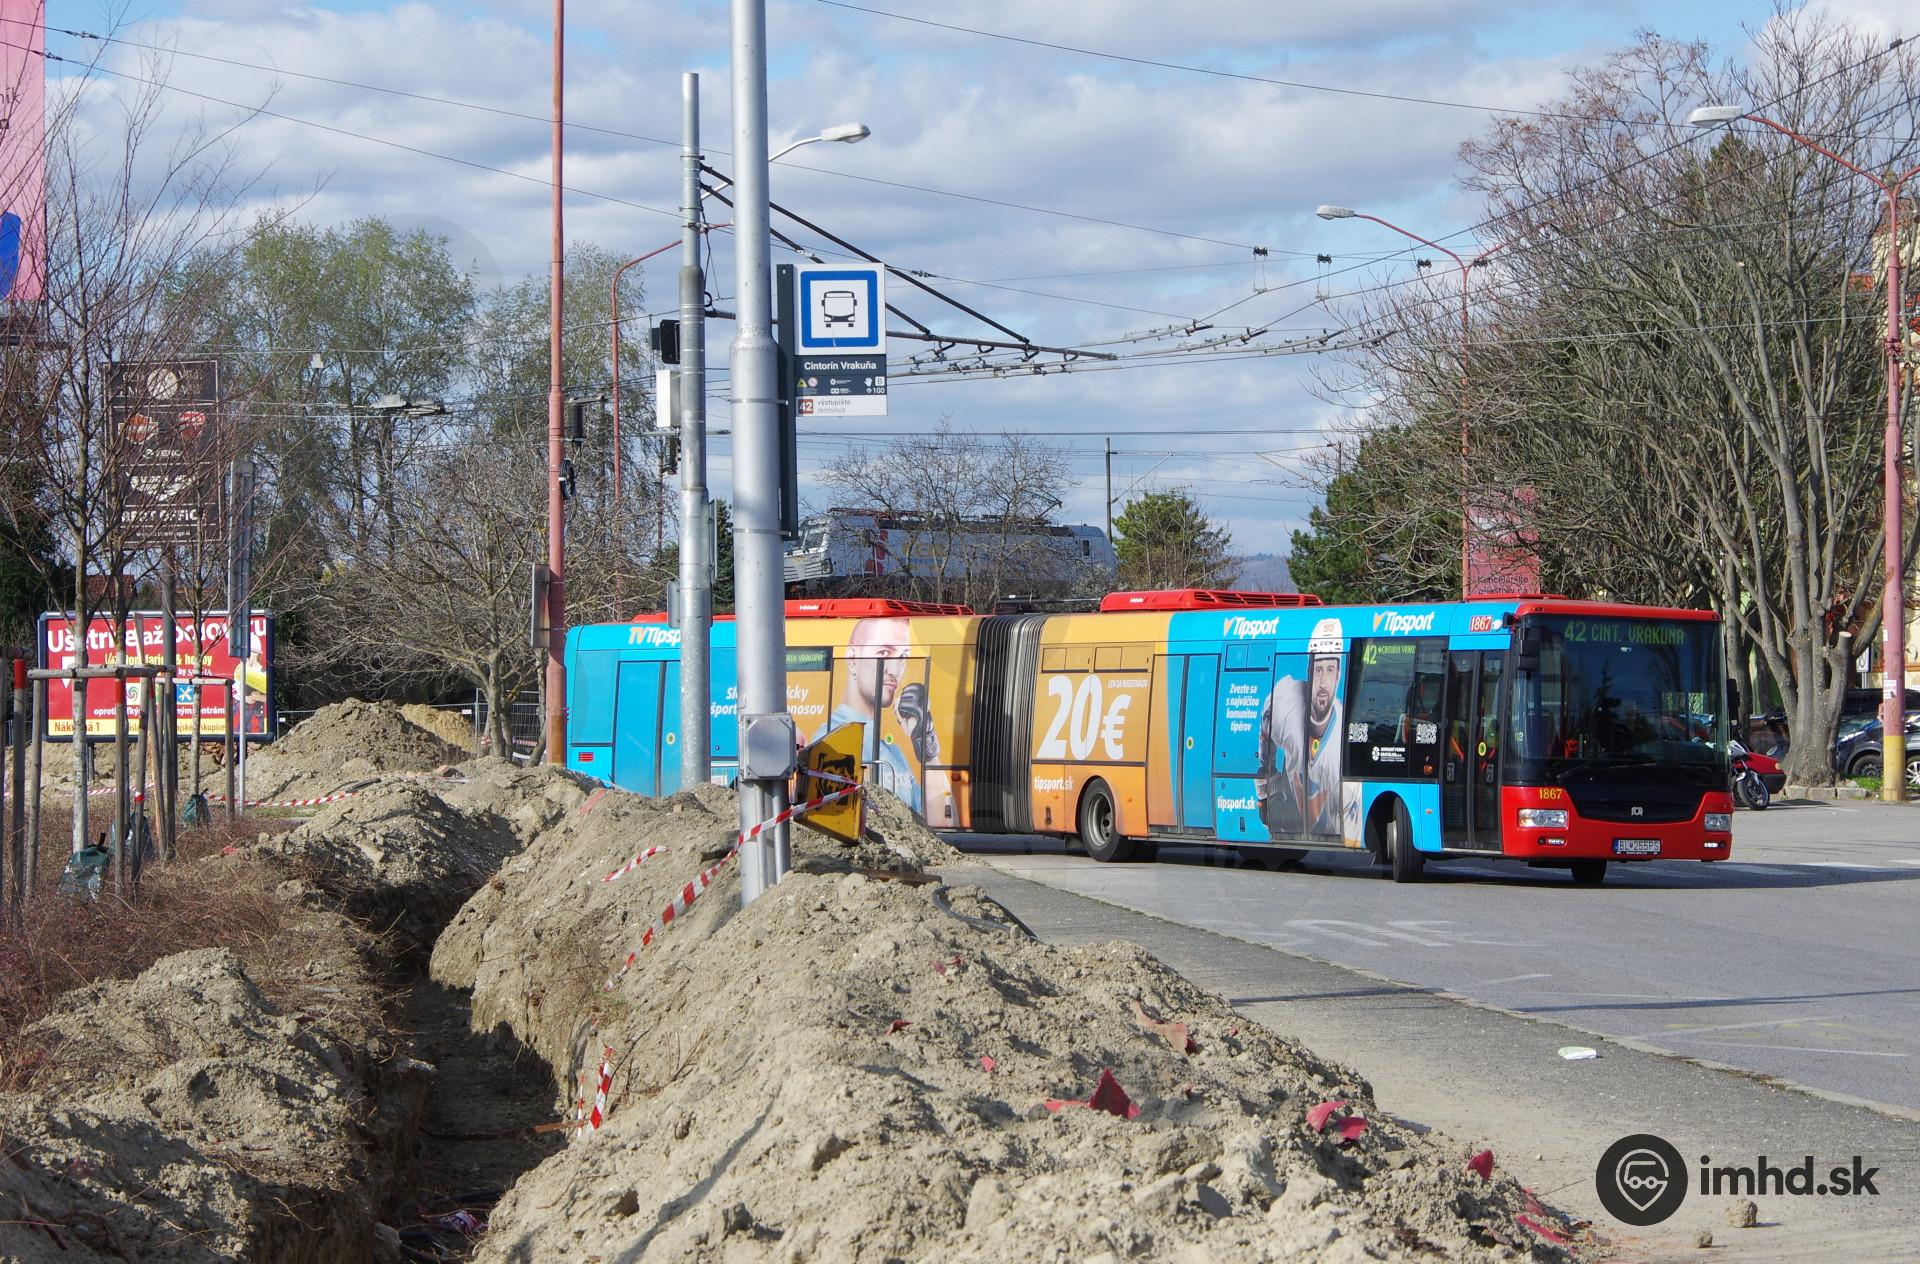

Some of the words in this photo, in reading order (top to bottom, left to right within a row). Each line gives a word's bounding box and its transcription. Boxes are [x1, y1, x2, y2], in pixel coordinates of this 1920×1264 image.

[804, 361, 838, 370] Cintorín
[840, 361, 877, 370] Vrakuňa
[799, 401, 813, 412] 42
[1233, 616, 1280, 640] Tipsport
[1384, 611, 1436, 635] Tipsport
[1471, 616, 1492, 631] 1867
[1564, 620, 1586, 642] 42
[1591, 623, 1622, 642] CINT.
[1362, 644, 1377, 665] 42
[1229, 683, 1249, 694] Zvezte
[1250, 685, 1258, 694] sa
[1230, 696, 1259, 709] najväčšou
[1226, 708, 1258, 719] komunitou
[1230, 721, 1252, 733] tipérov
[1034, 776, 1074, 792] tipsport.sk
[1539, 787, 1563, 800] 1867
[1217, 795, 1256, 812] tipsport.sk
